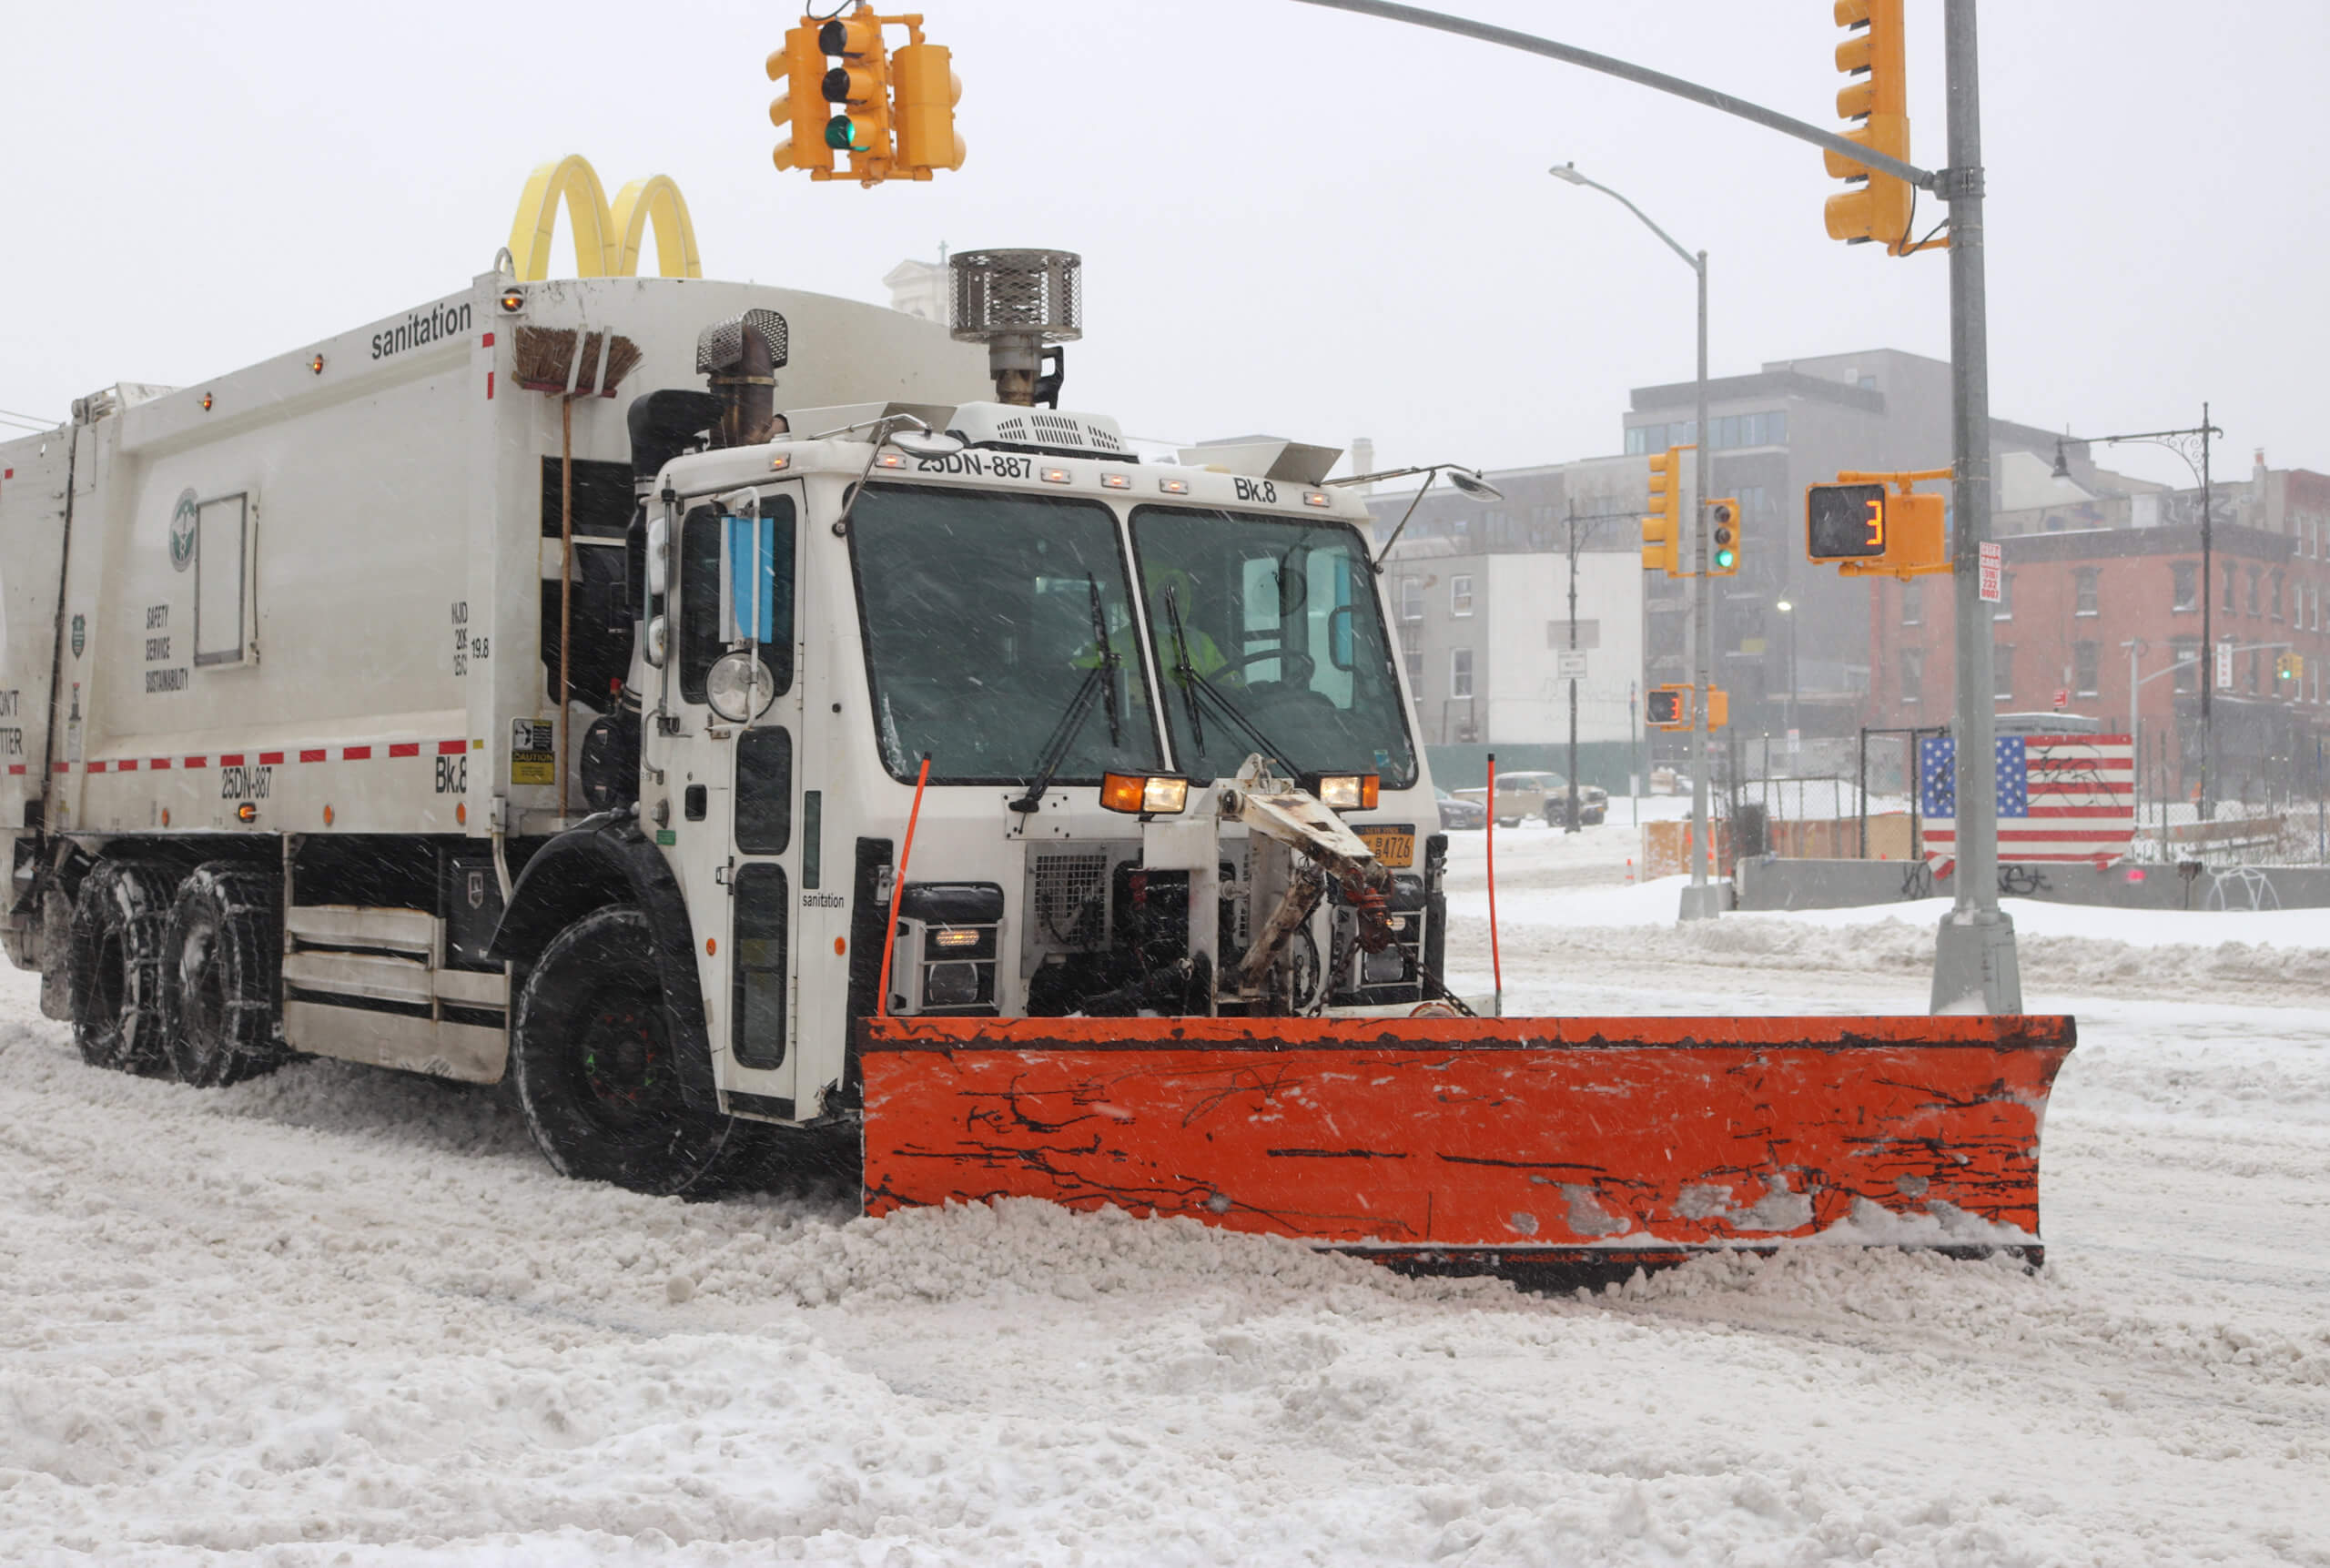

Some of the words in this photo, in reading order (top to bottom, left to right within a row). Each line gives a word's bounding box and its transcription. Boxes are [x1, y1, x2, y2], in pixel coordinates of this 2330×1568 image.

[371, 302, 471, 360] sanitation
[1233, 477, 1277, 503] Bk.8
[1866, 500, 1882, 545] 3
[147, 604, 169, 630] SAFETY
[146, 636, 170, 662] SERVICE
[471, 637, 489, 659] 19.8
[512, 752, 554, 763] CAUTION
[221, 766, 272, 799] 25DN-887
[1383, 836, 1411, 858] 4726
[803, 892, 845, 909] sanitation
